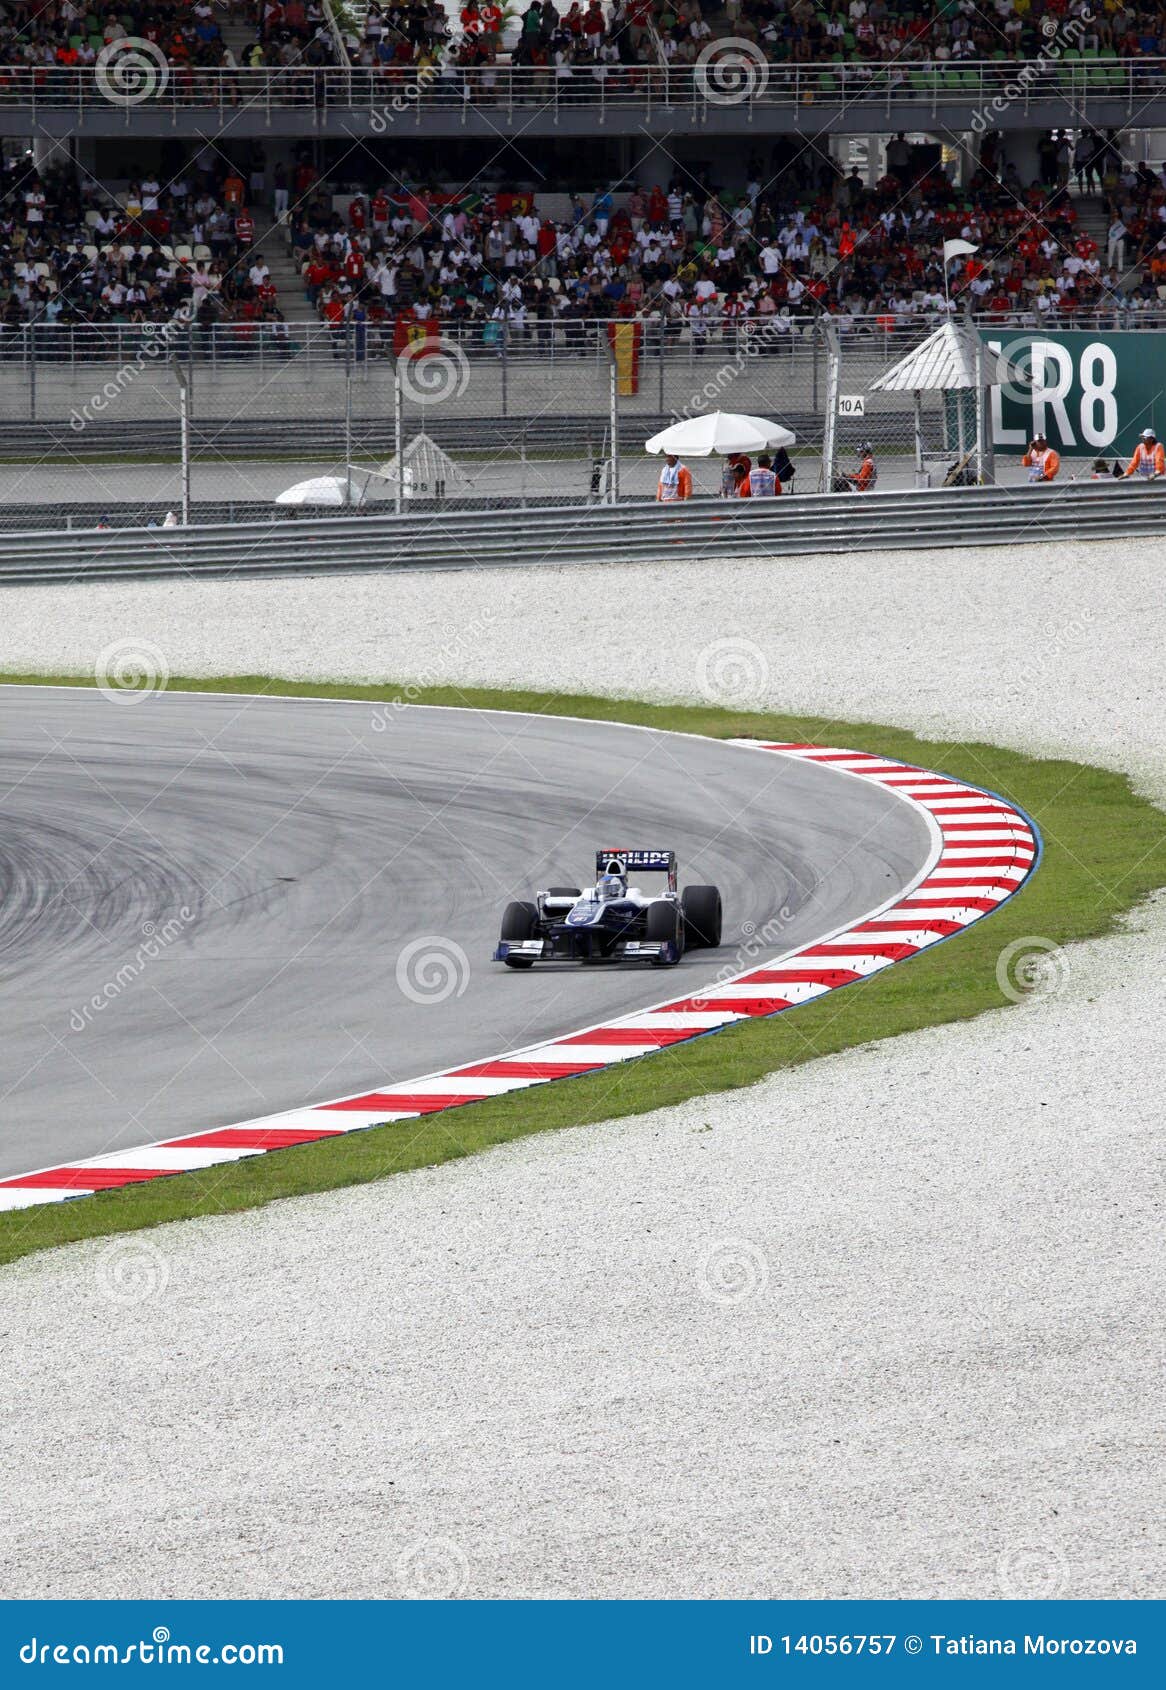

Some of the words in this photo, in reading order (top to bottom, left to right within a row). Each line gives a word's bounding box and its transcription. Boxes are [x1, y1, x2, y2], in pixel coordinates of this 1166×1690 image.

[840, 399, 851, 412] 10
[854, 399, 862, 412] A
[602, 852, 670, 864] PHILIPS
